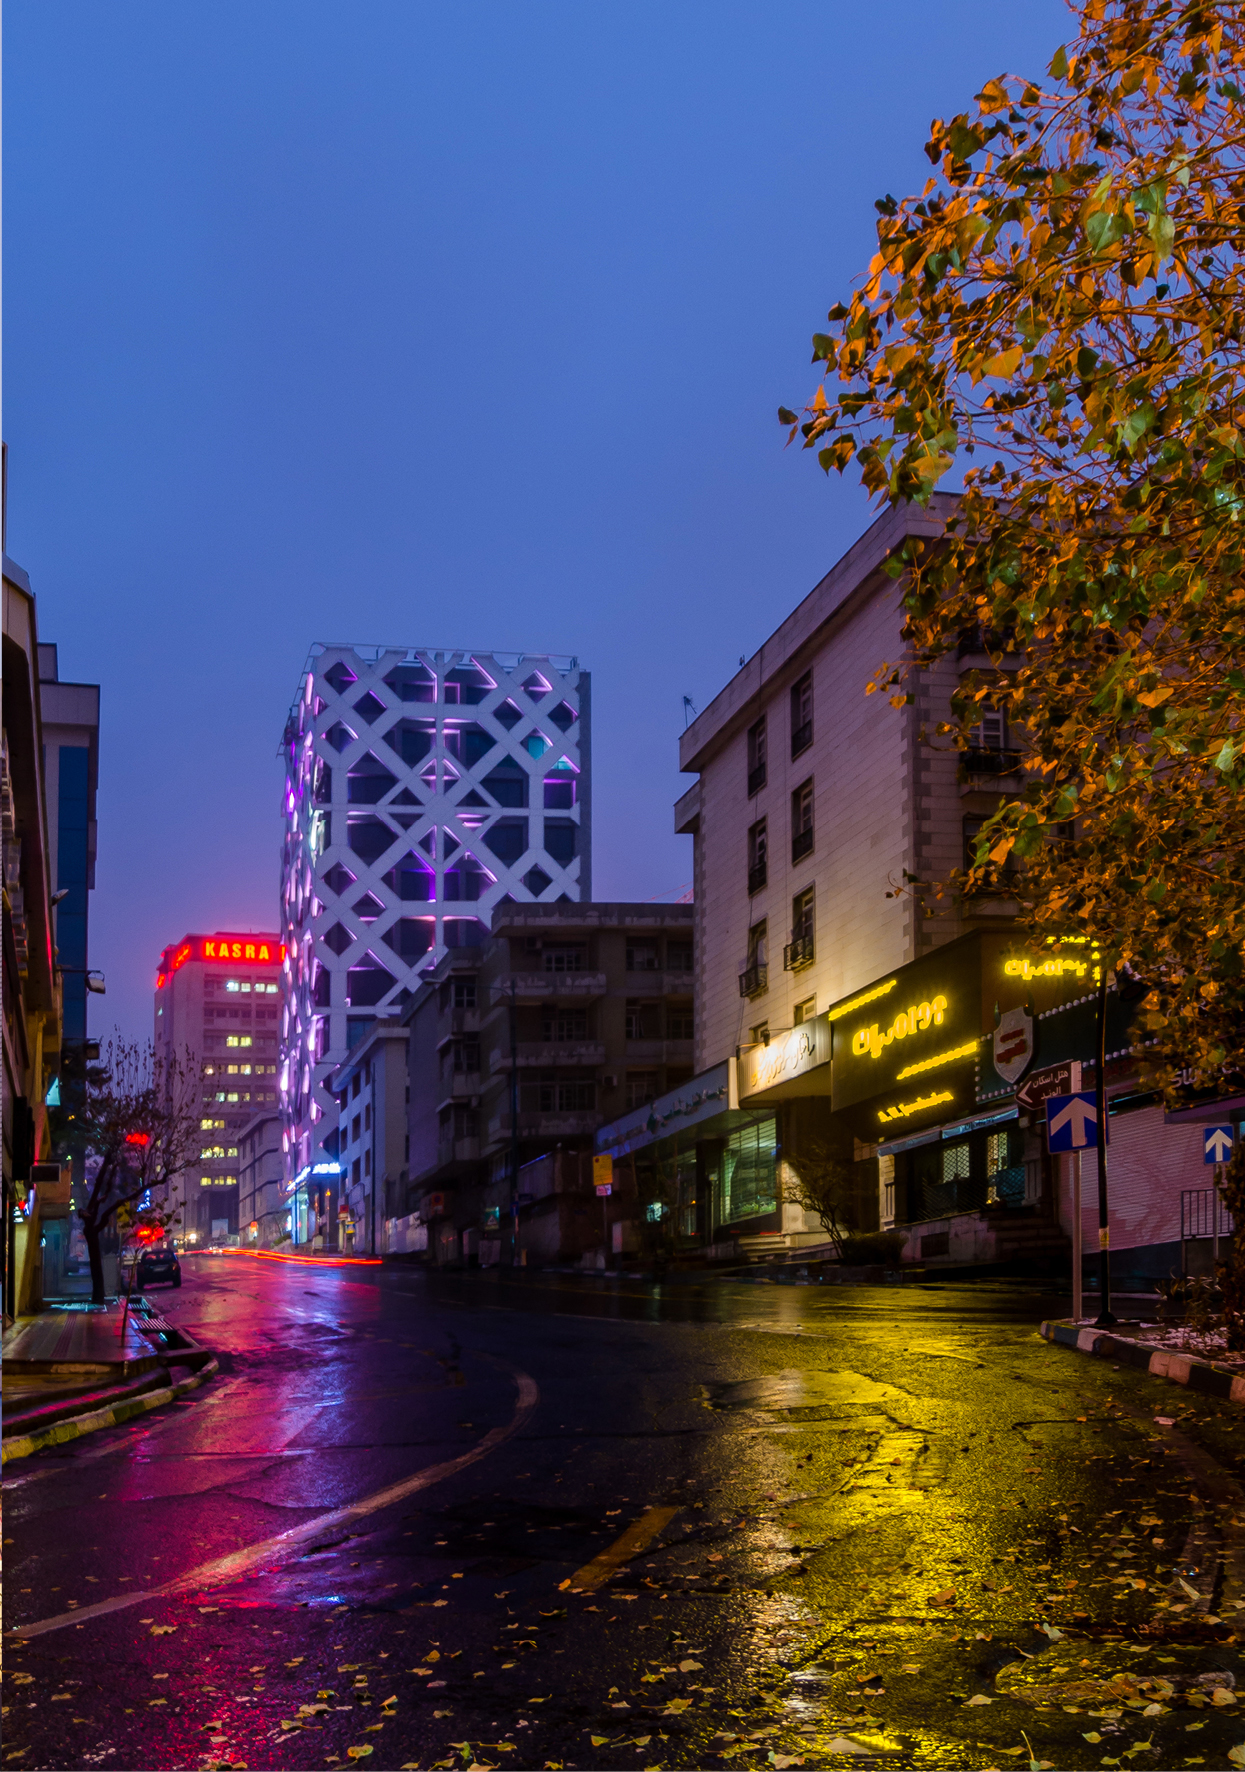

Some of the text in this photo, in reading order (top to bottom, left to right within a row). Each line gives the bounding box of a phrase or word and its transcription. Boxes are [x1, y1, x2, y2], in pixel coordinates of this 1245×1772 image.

[205, 941, 269, 960] KASRA
[1032, 1073, 1053, 1088] اسکان
[1054, 1070, 1069, 1083] هتل
[1040, 1086, 1061, 1100] الوند
